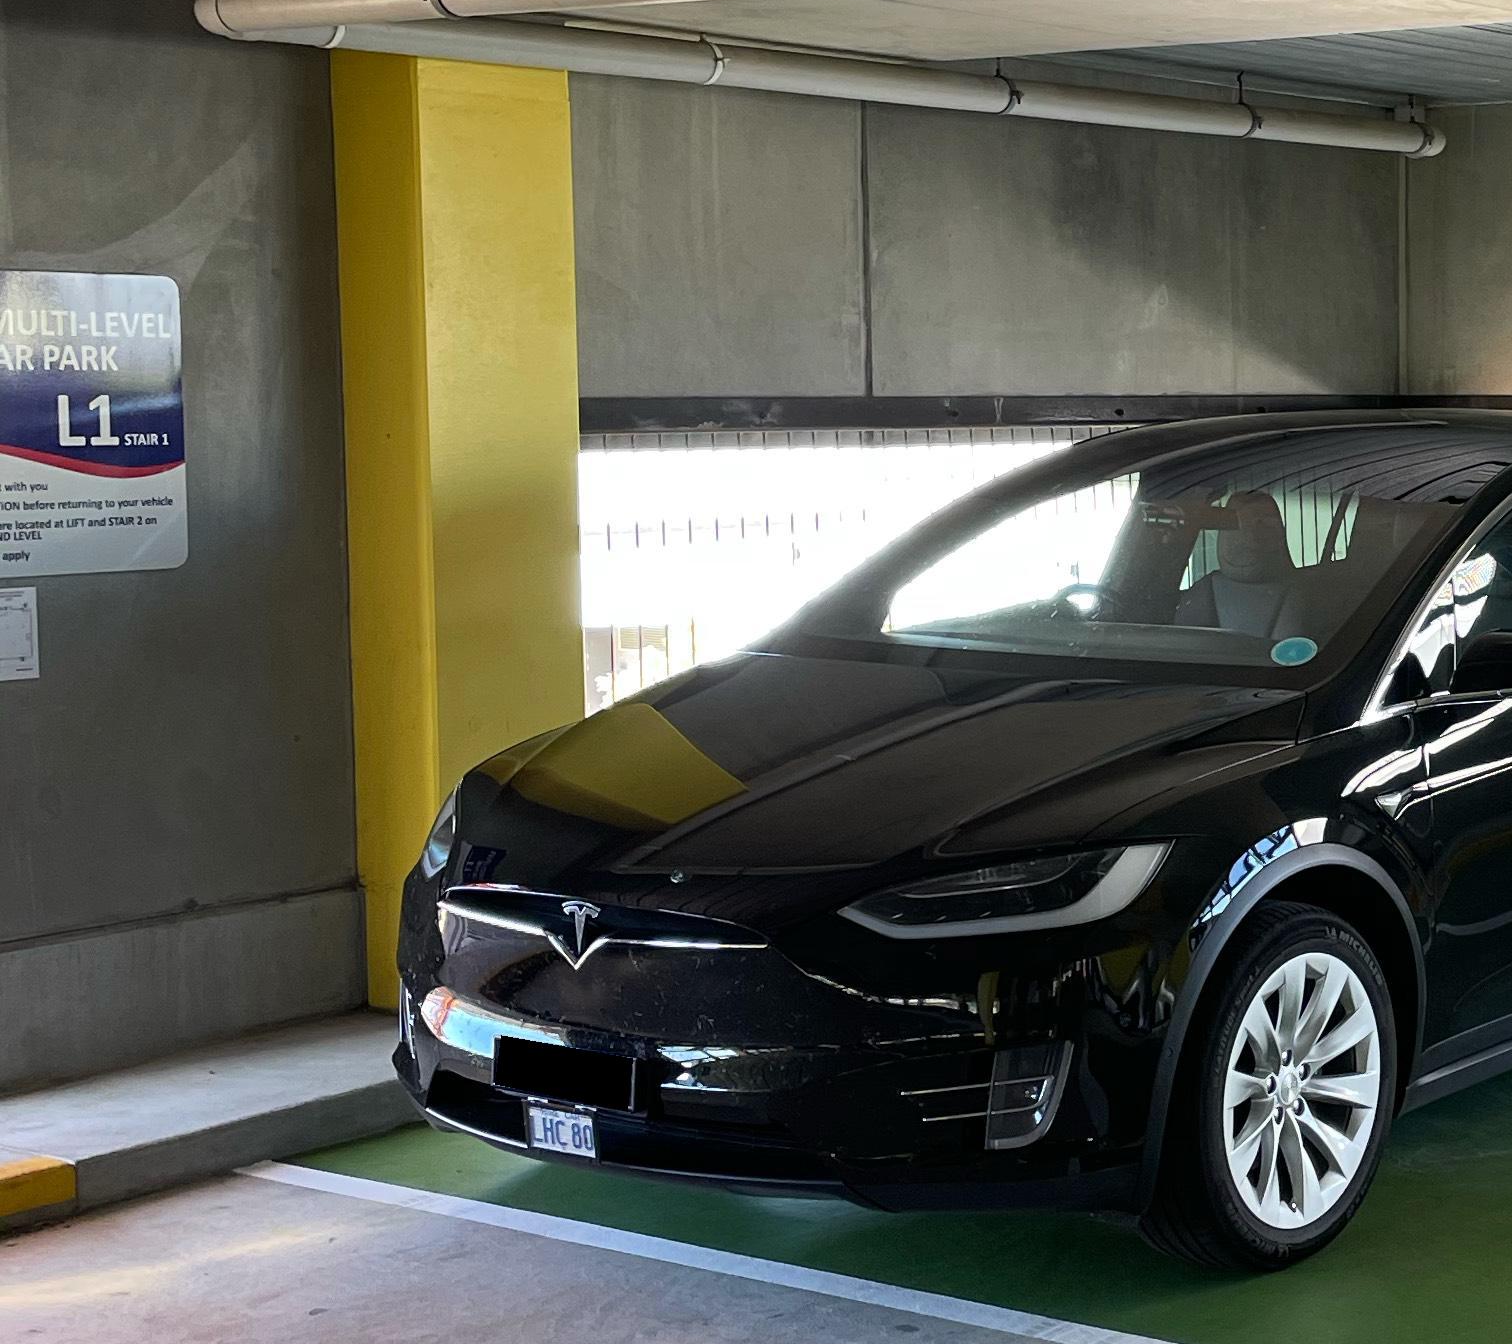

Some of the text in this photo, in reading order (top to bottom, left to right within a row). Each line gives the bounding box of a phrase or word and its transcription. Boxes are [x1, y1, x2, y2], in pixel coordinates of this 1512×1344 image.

[43, 344, 119, 372] PARK
[57, 394, 169, 447] L1 STAIR 1
[5, 482, 48, 493] with you
[23, 500, 55, 510] before
[57, 499, 103, 510] returning
[105, 499, 115, 508] to
[118, 499, 139, 510] your
[141, 496, 173, 506] vehicle
[15, 519, 51, 529] located
[54, 519, 63, 528] at
[66, 518, 86, 528] LIFT
[88, 517, 106, 527] and
[108, 517, 135, 527] STAIR
[137, 516, 143, 526] 2
[145, 517, 157, 525] on
[14, 531, 42, 541] LEVEL
[3, 551, 30, 561] apply
